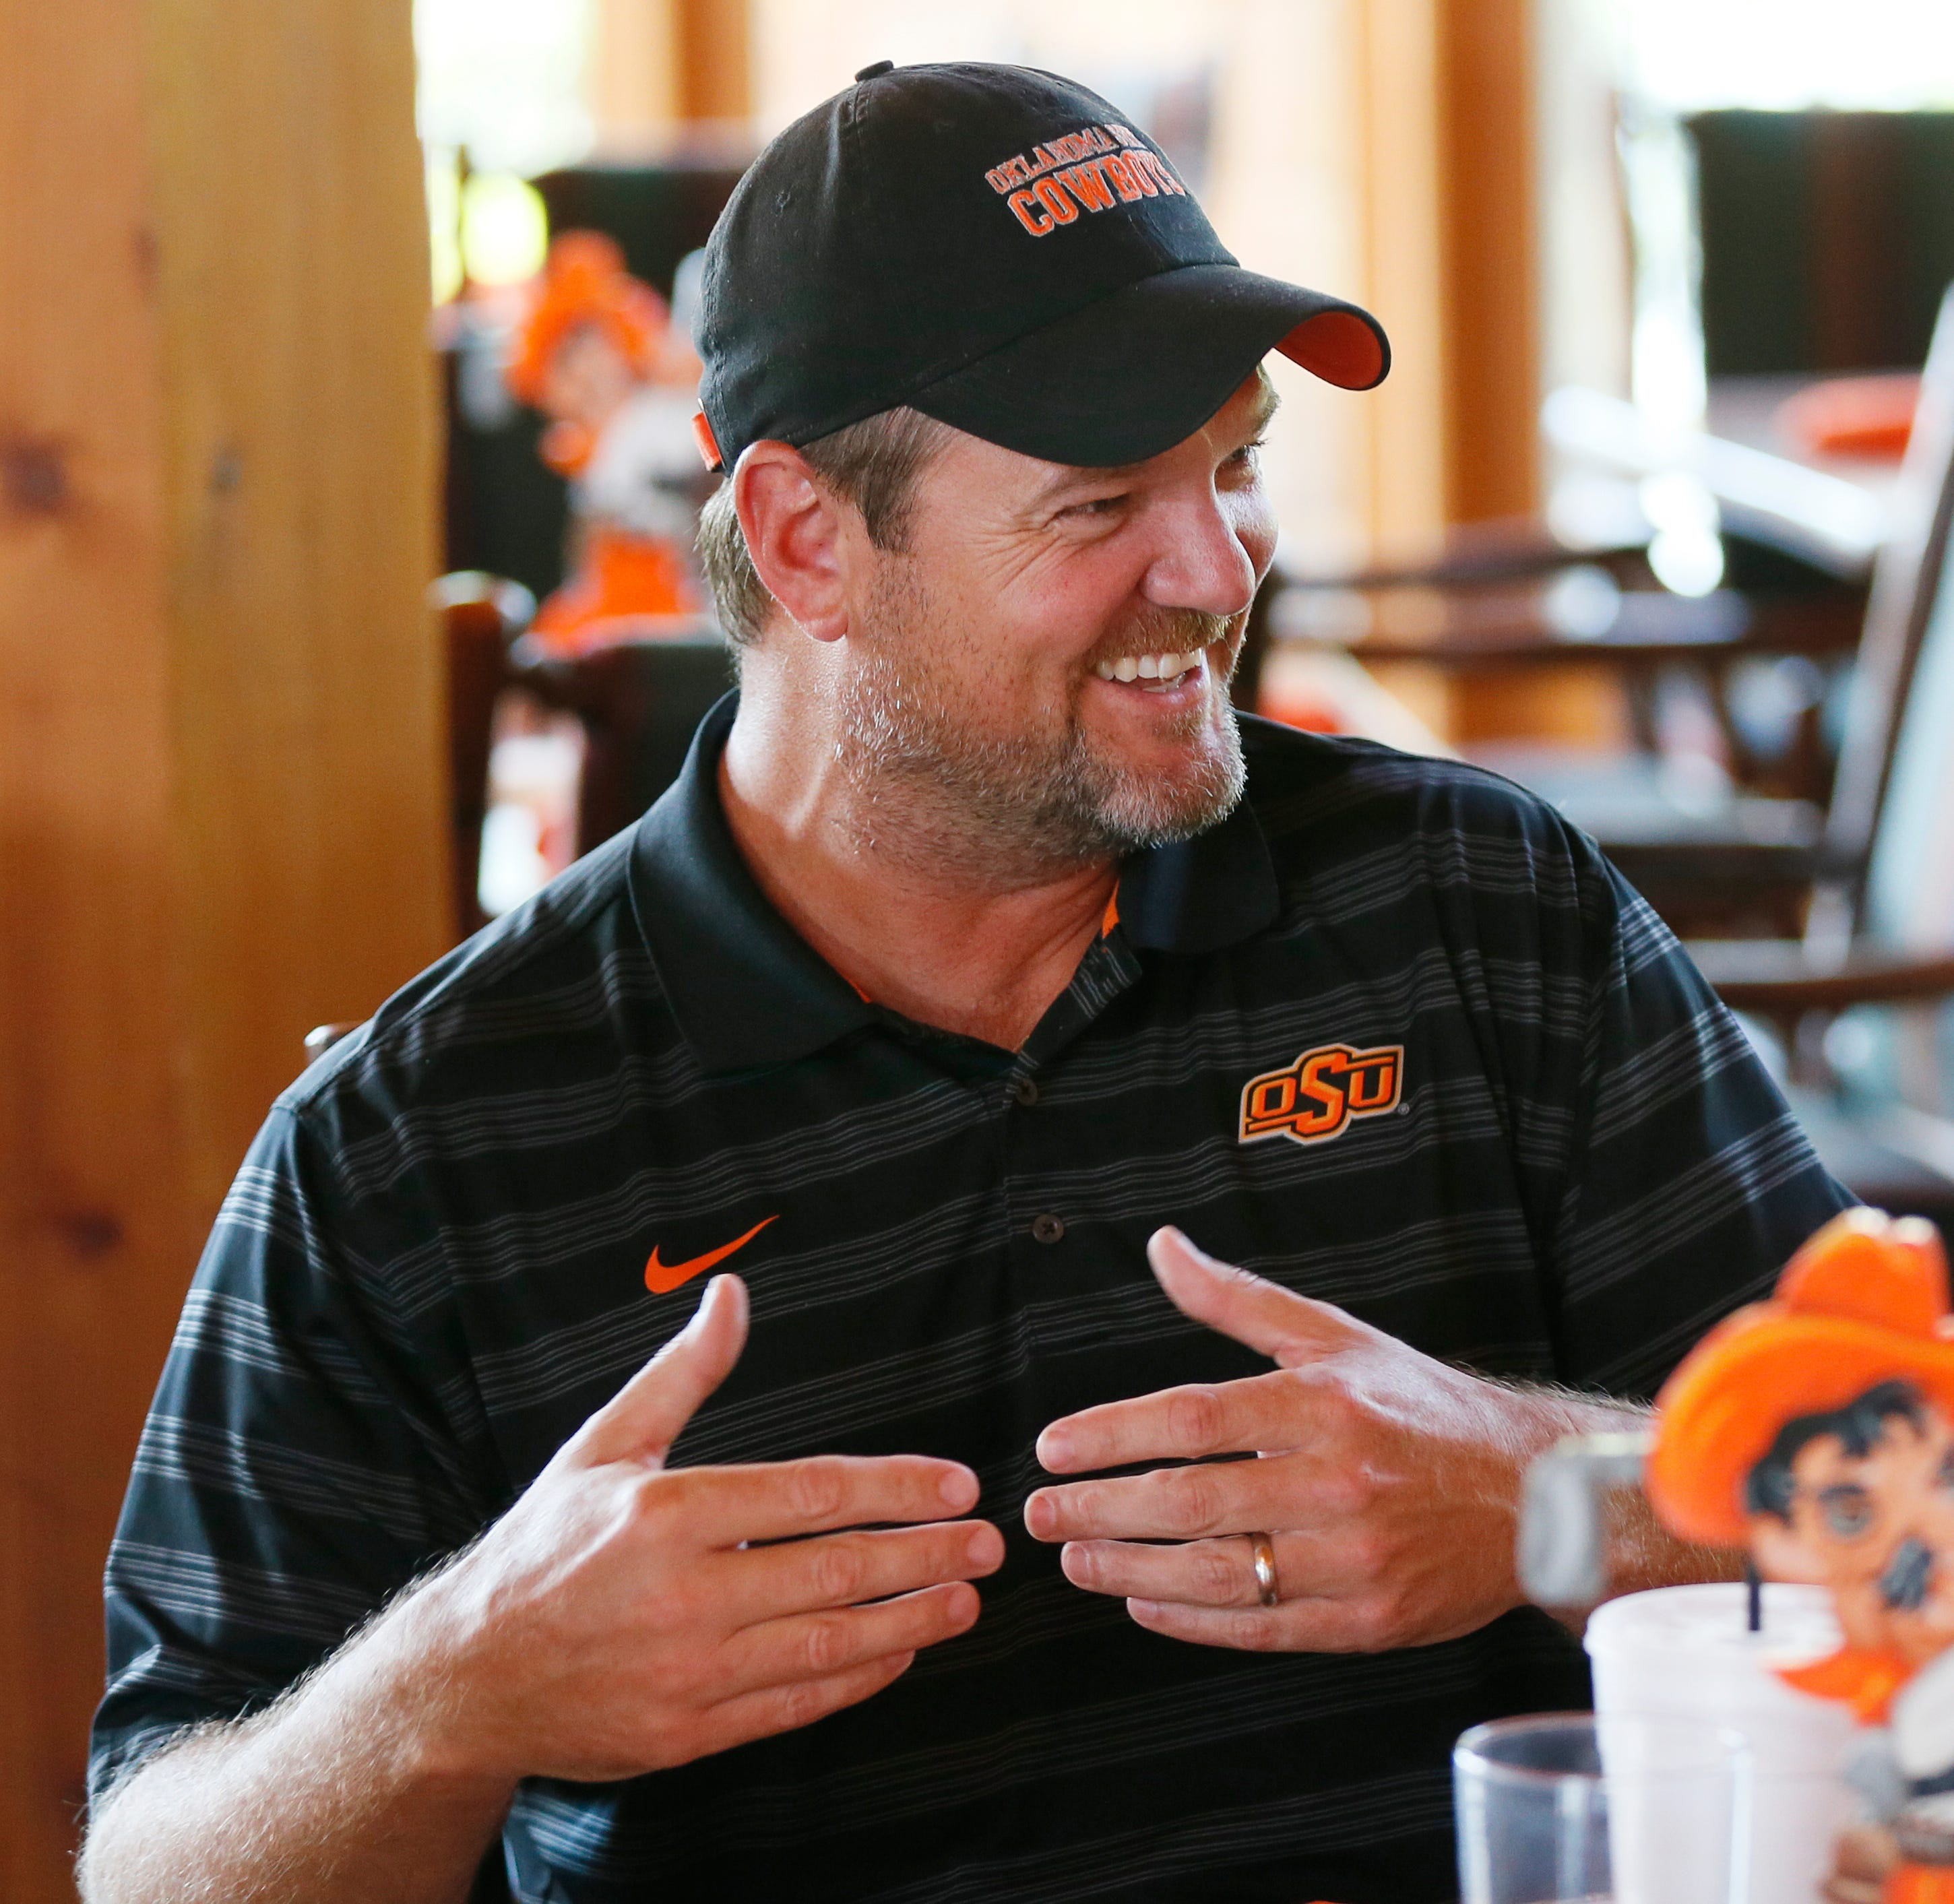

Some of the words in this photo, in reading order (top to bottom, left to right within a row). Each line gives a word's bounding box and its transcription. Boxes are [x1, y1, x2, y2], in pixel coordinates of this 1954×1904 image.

[984, 126, 1120, 195] OKLAHOMA
[1007, 150, 1186, 238] COWBOYS
[1249, 1051, 1395, 1135] OSU
